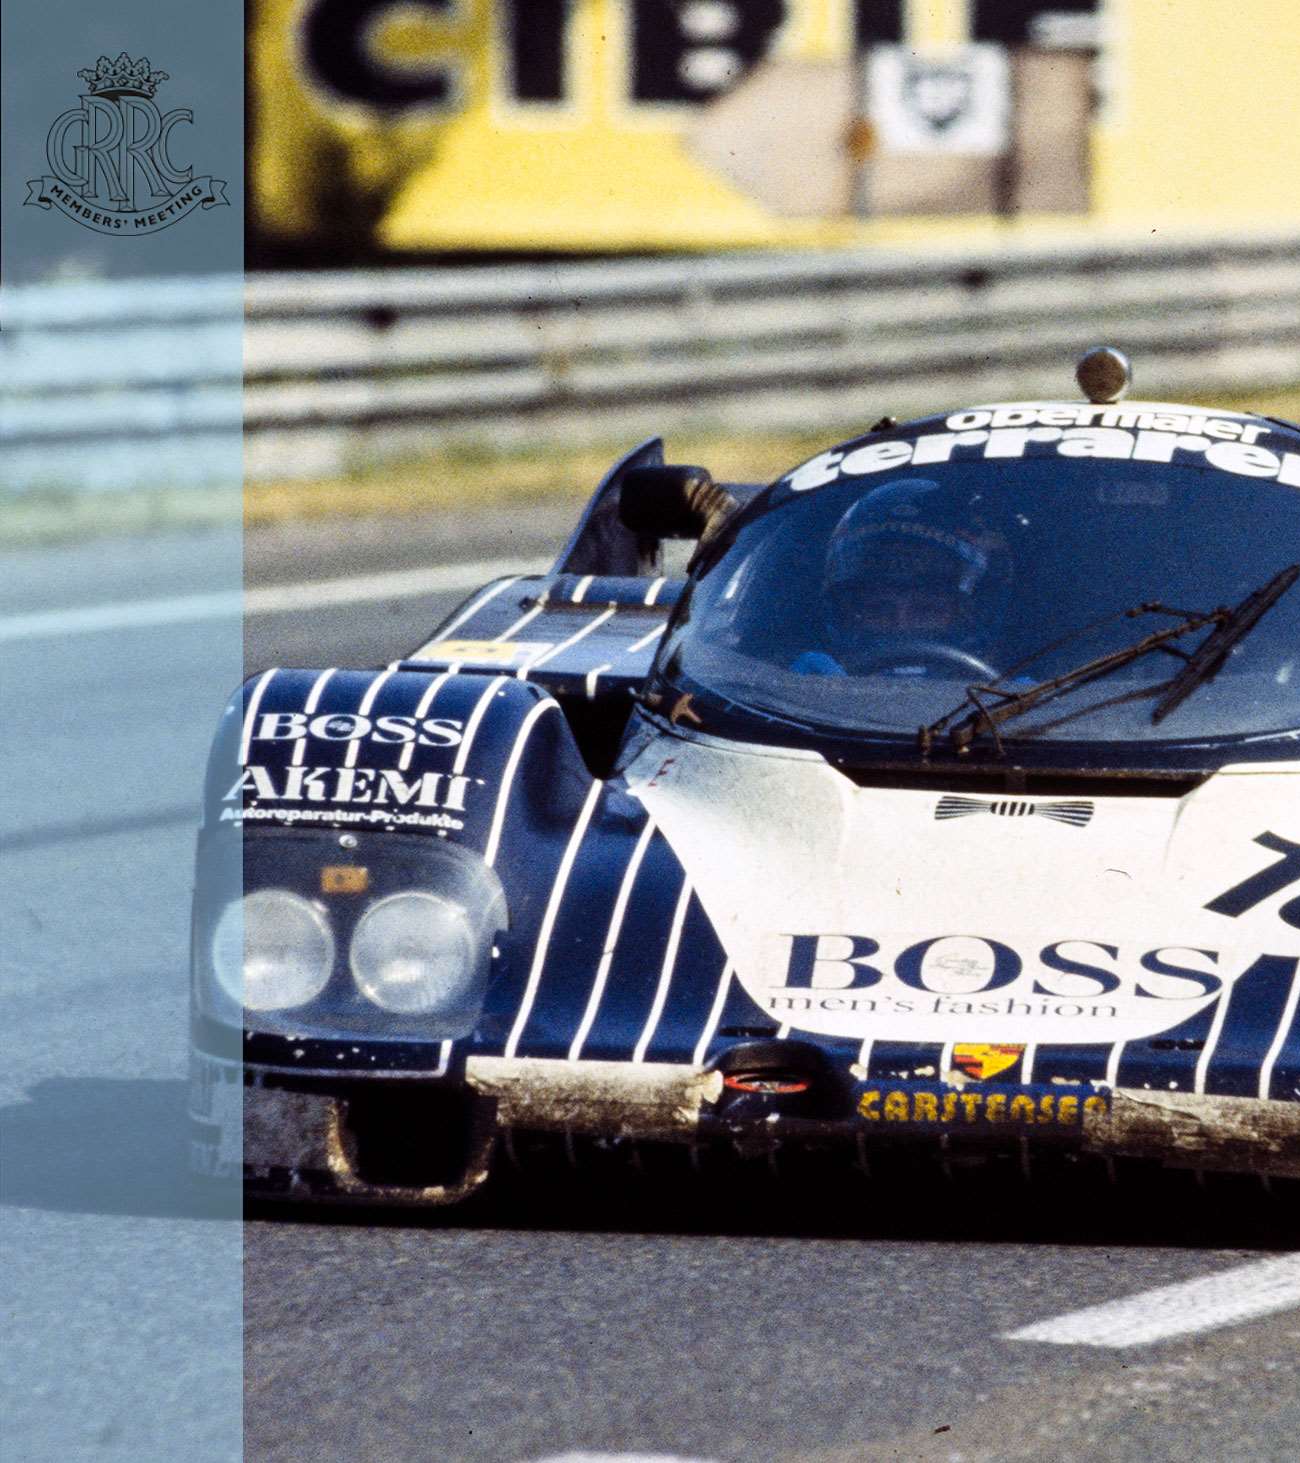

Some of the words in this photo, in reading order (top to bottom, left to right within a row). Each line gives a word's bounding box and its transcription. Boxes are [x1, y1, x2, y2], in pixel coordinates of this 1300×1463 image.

[252, 712, 464, 748] BOSS
[222, 764, 472, 812] AKEMI
[770, 932, 1224, 999] BOSS
[768, 995, 914, 1014] men's
[931, 996, 1120, 1018] fashion
